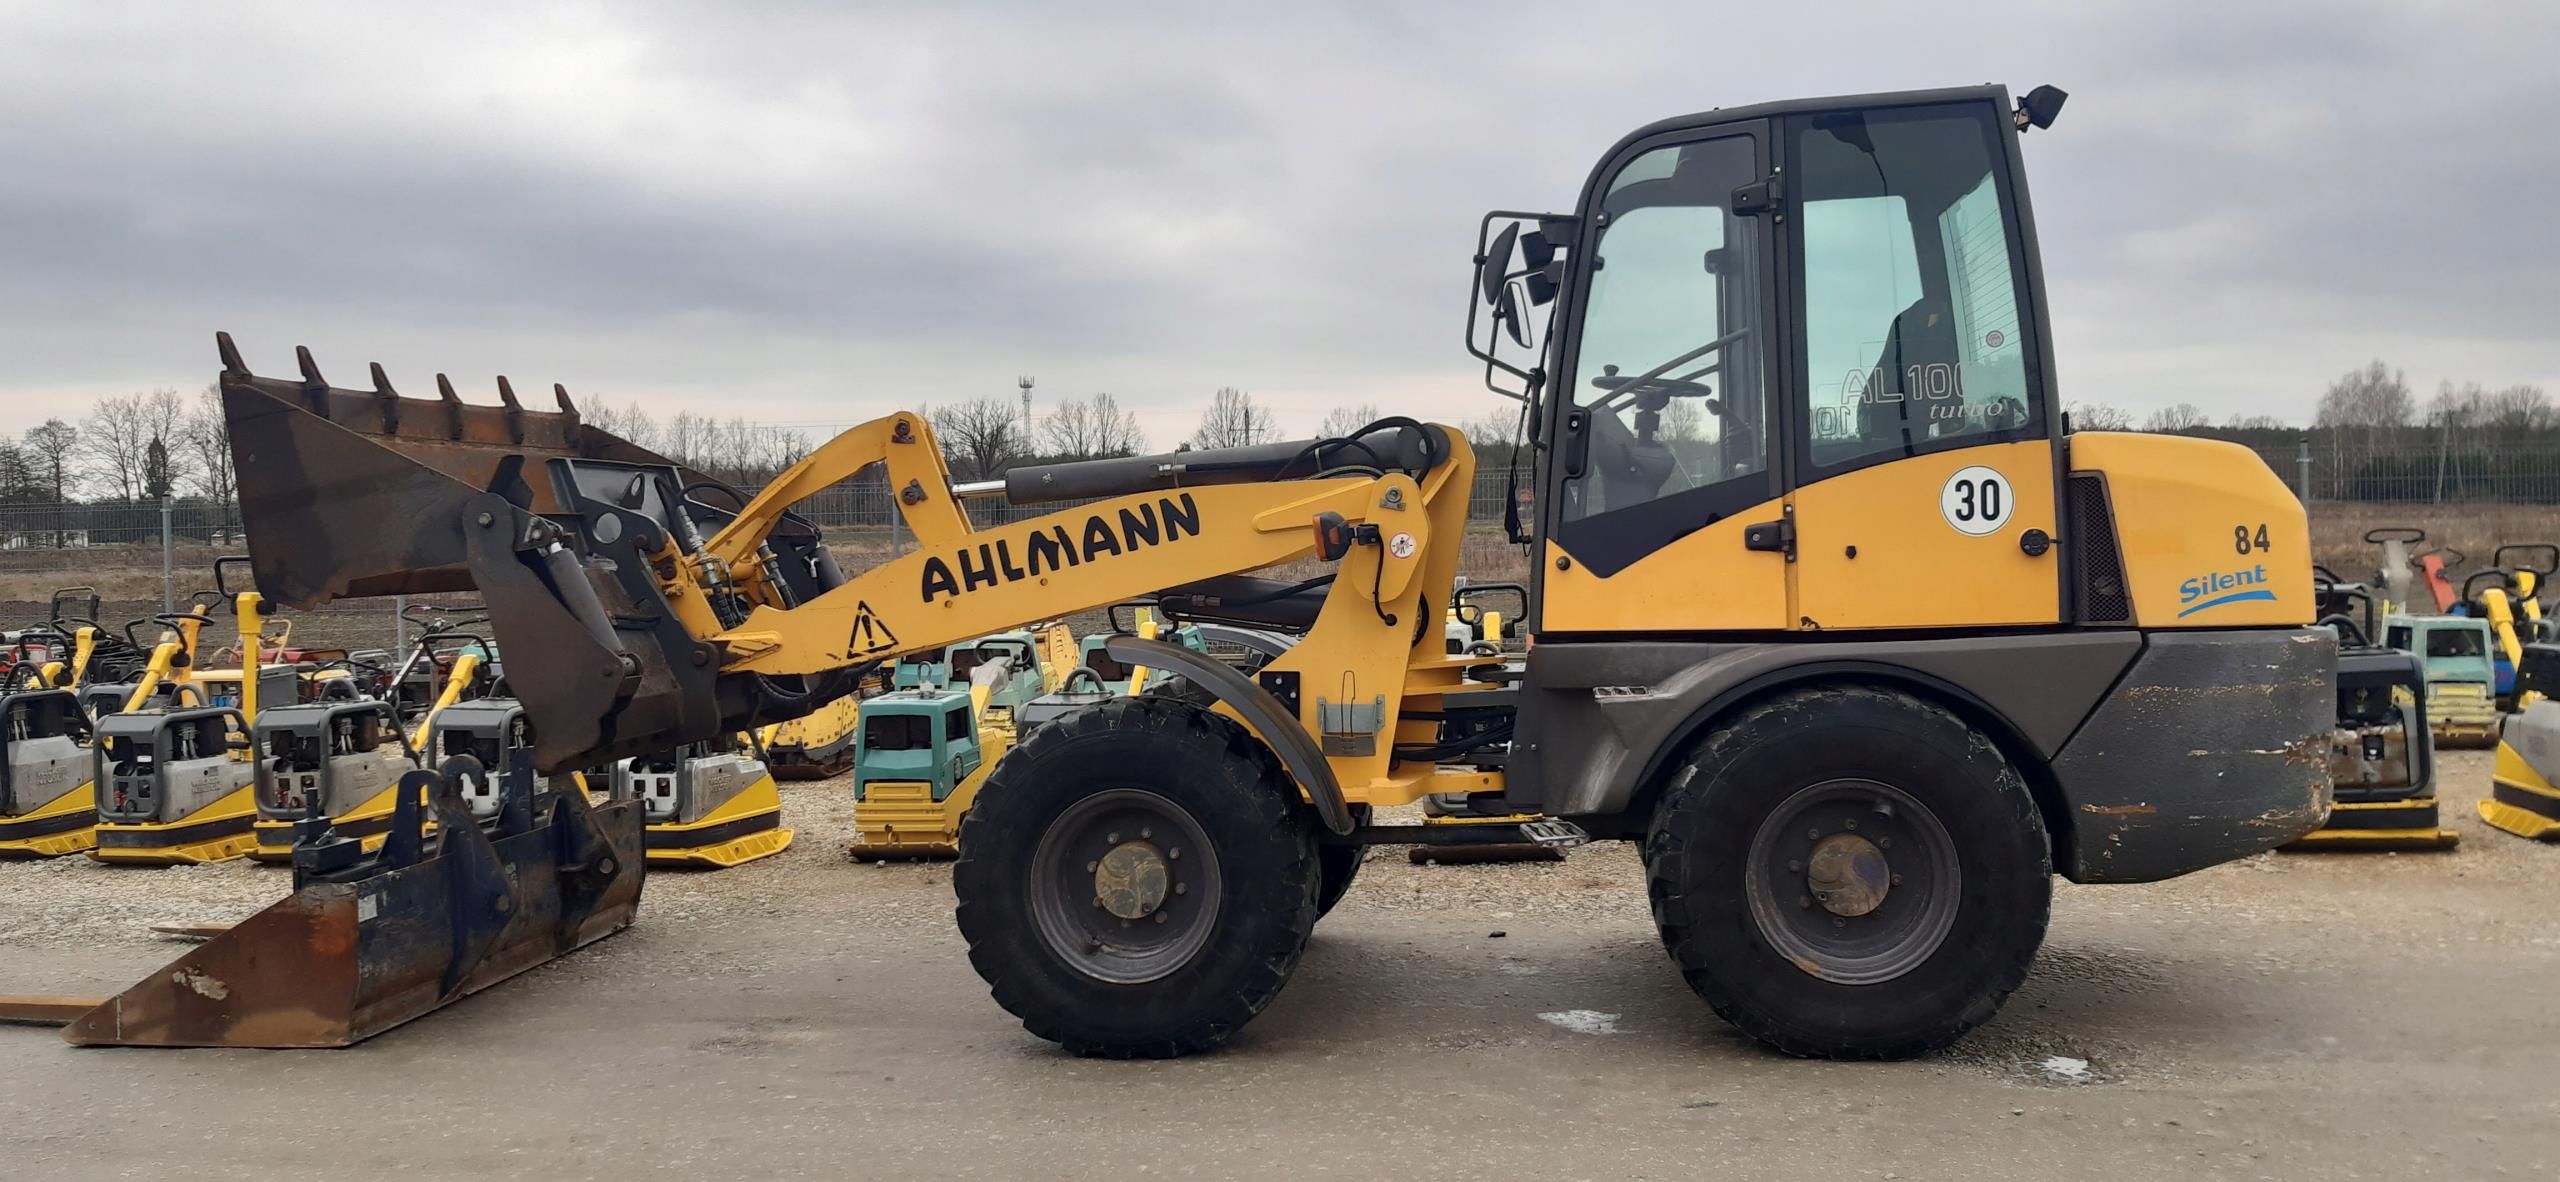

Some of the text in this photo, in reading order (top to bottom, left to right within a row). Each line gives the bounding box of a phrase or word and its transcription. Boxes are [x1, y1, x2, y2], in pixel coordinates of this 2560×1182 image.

[1840, 366, 1905, 404] AL
[1955, 479, 2000, 521] 30
[922, 493, 1200, 603] AHLMANN
[2234, 523, 2271, 555] 84
[2179, 564, 2268, 604] Silent
